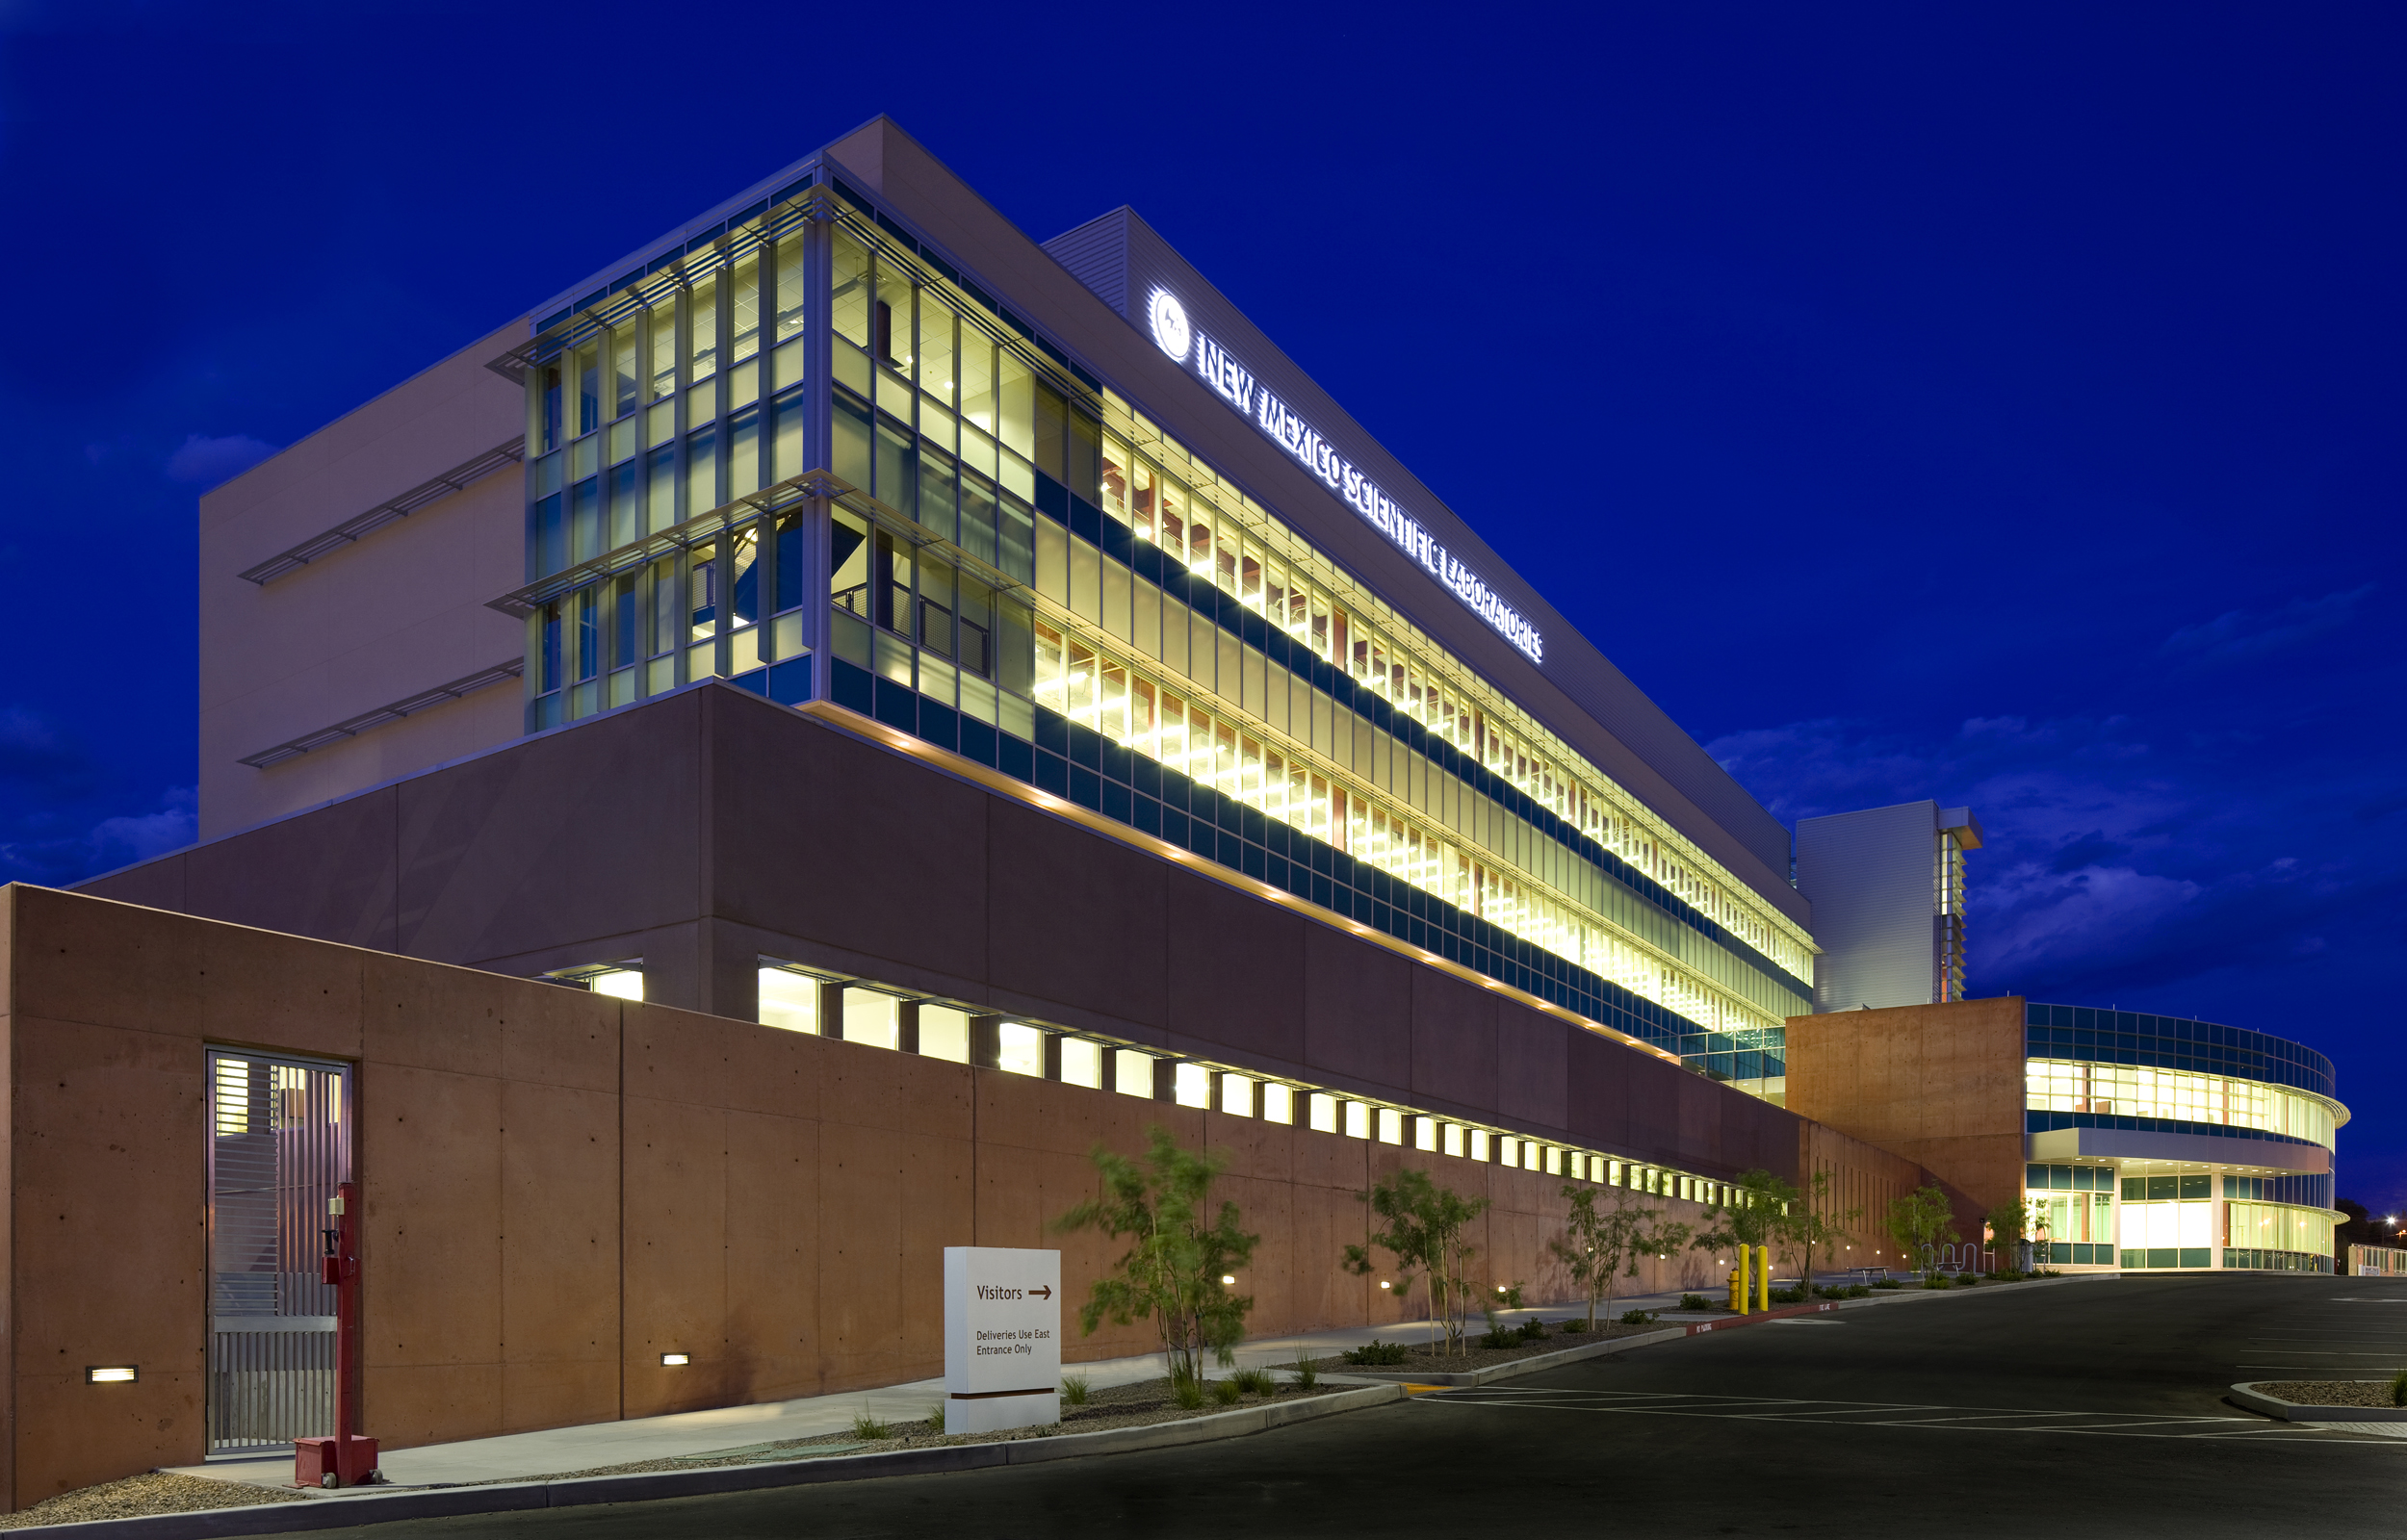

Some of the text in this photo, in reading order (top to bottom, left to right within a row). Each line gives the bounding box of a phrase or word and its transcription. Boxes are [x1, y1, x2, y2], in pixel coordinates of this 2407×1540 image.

[1204, 336, 1545, 662] NEW MEXICO SCIENTIFIC LABORATORIES
[976, 1285, 1022, 1300] Visitors
[976, 1328, 1050, 1341] Deliveries Use East
[976, 1343, 1032, 1356] Entrance Only
